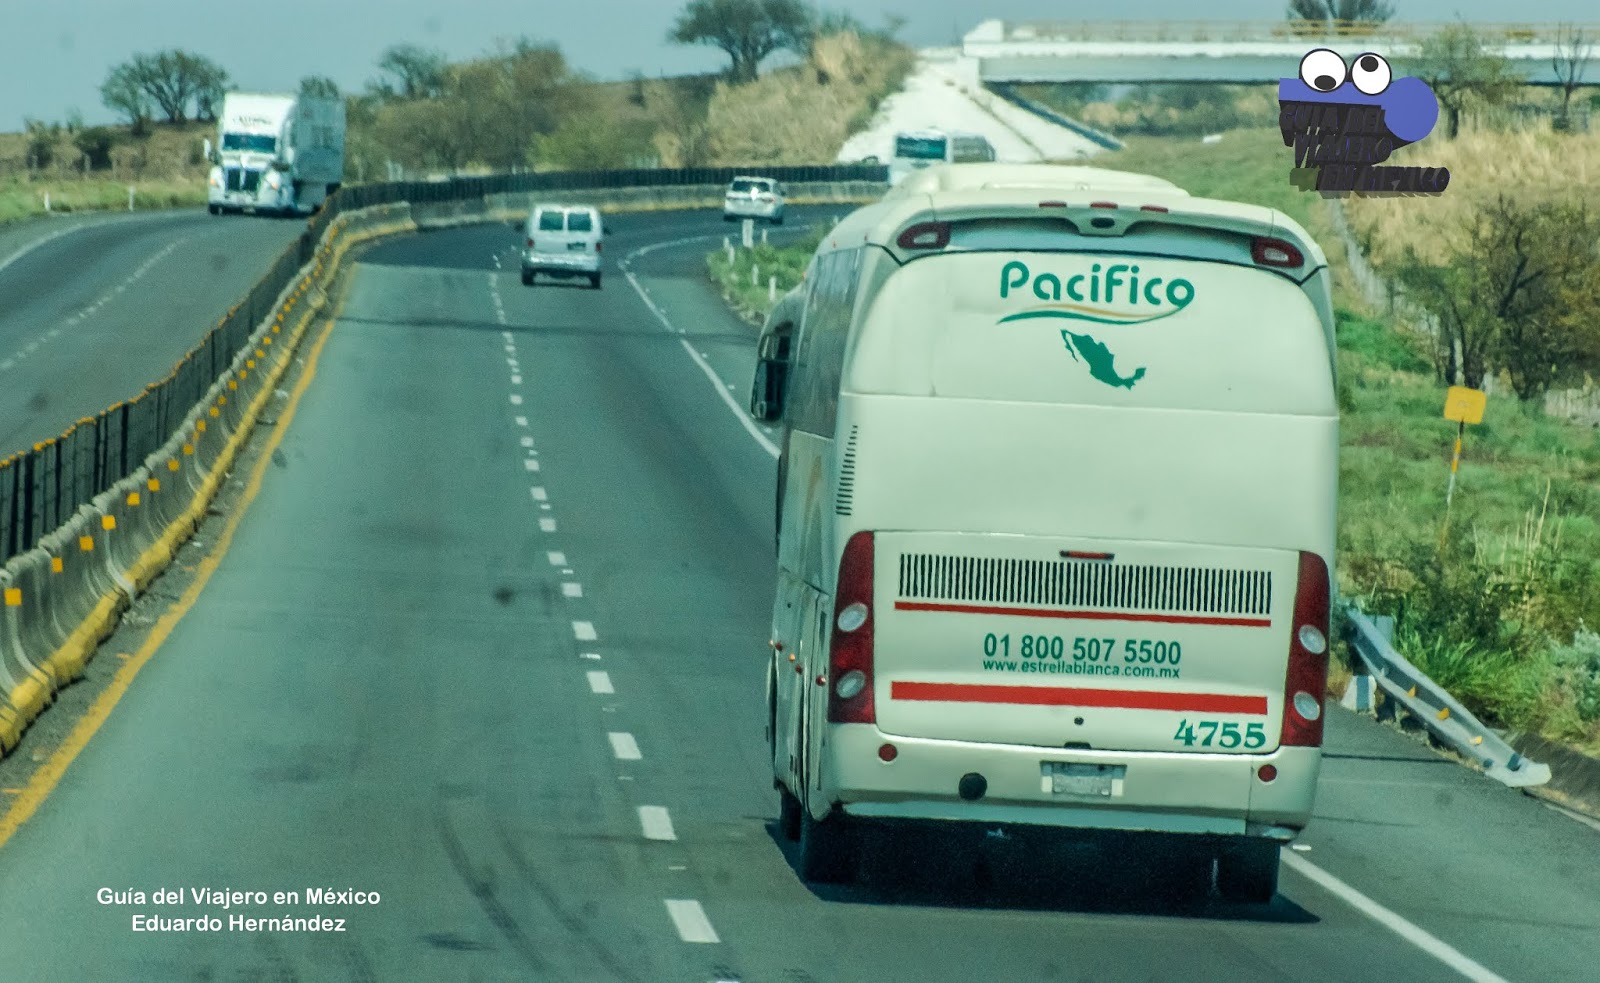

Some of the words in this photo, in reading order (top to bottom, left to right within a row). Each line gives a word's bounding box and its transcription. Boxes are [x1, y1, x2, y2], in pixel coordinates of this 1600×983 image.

[983, 633, 1010, 657] 01
[1021, 635, 1064, 660] 800
[1073, 637, 1116, 662] 507
[1124, 639, 1181, 665] 5500
[983, 659, 1180, 679] www.estrellablanca.com.mx
[1174, 718, 1267, 749] 4755
